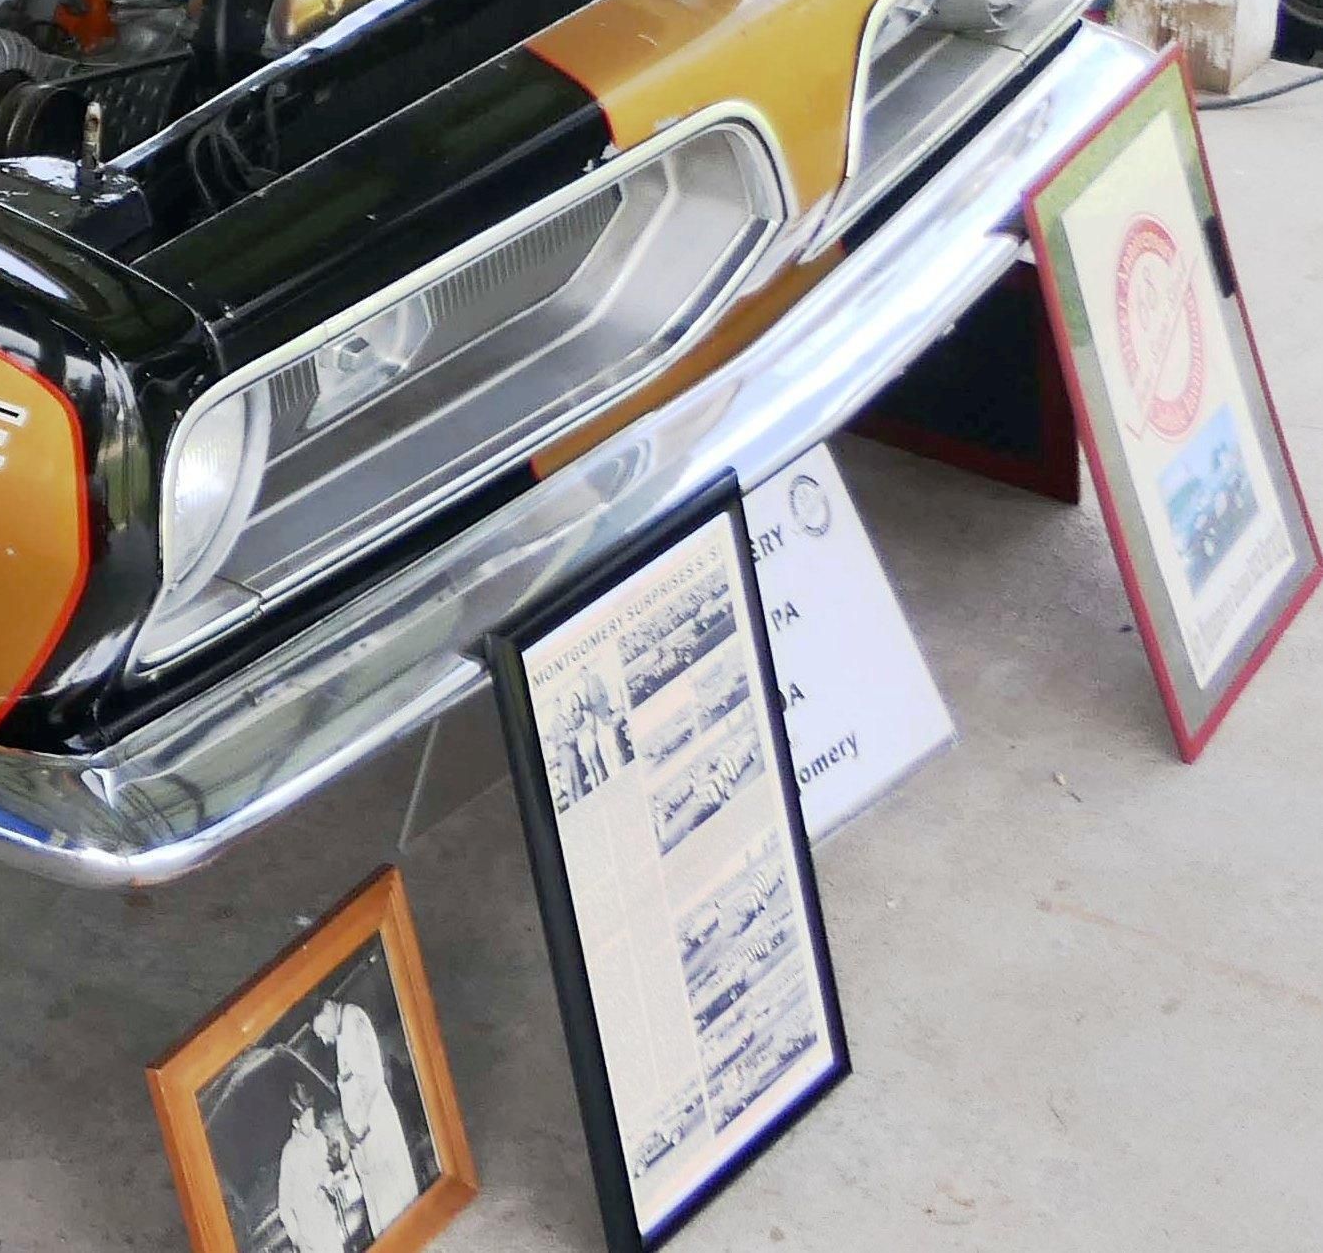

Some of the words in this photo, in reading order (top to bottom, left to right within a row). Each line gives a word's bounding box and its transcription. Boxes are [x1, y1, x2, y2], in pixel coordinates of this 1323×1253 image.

[751, 524, 784, 563] ERY
[771, 600, 801, 632] PA
[799, 733, 859, 785] omery
